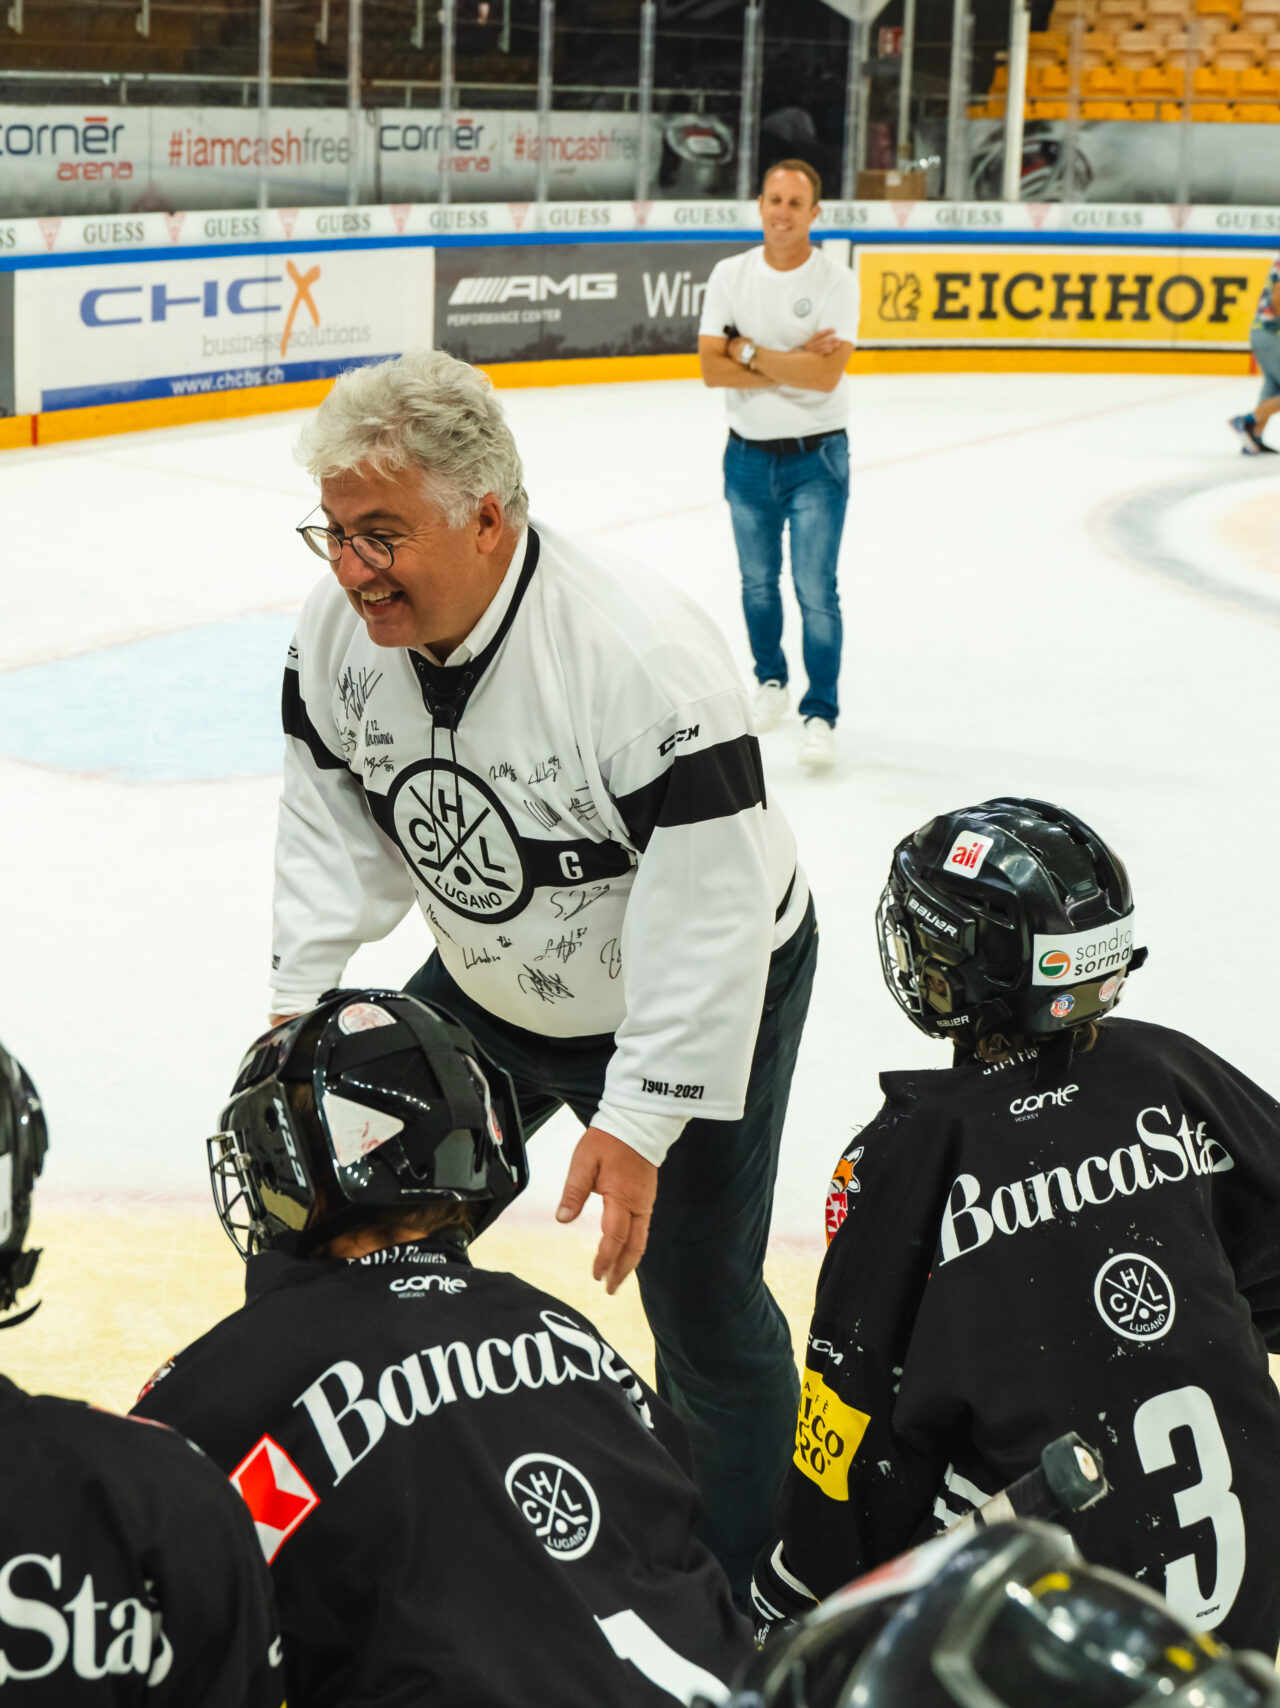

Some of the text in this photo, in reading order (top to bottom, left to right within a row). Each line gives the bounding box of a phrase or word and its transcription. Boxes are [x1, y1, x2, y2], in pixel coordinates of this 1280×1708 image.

[169, 127, 352, 169] #iamcashfree
[57, 160, 134, 182] arena
[437, 153, 491, 174] arena
[316, 212, 373, 235] GUESS
[429, 209, 490, 230] GUESS
[548, 207, 612, 228] GUESS
[673, 206, 739, 225] GUESS
[820, 207, 869, 225] UESS
[935, 206, 1004, 227] GUESS
[1072, 209, 1145, 229] GUESS
[83, 222, 146, 246] GUESS
[204, 217, 262, 240] GUESS
[500, 273, 618, 303] AMG
[932, 272, 1249, 324] EICHHOF
[447, 308, 562, 327] PERFORMANCE CENTER
[202, 323, 372, 358] business solutions
[171, 365, 285, 395] www.chcbs.ch
[558, 850, 585, 881] G
[950, 841, 985, 871] ail
[433, 872, 504, 911] LUGANO
[907, 898, 960, 939] BAUER
[1074, 927, 1133, 963] sandro
[1073, 944, 1134, 977] sorma
[640, 1077, 706, 1101] 1941-2021
[1009, 1082, 1080, 1116] conte
[389, 1274, 468, 1295] conte
[1129, 1313, 1167, 1333] LUGANO
[1133, 1384, 1248, 1632] 3
[546, 1526, 588, 1550] LUGANO
